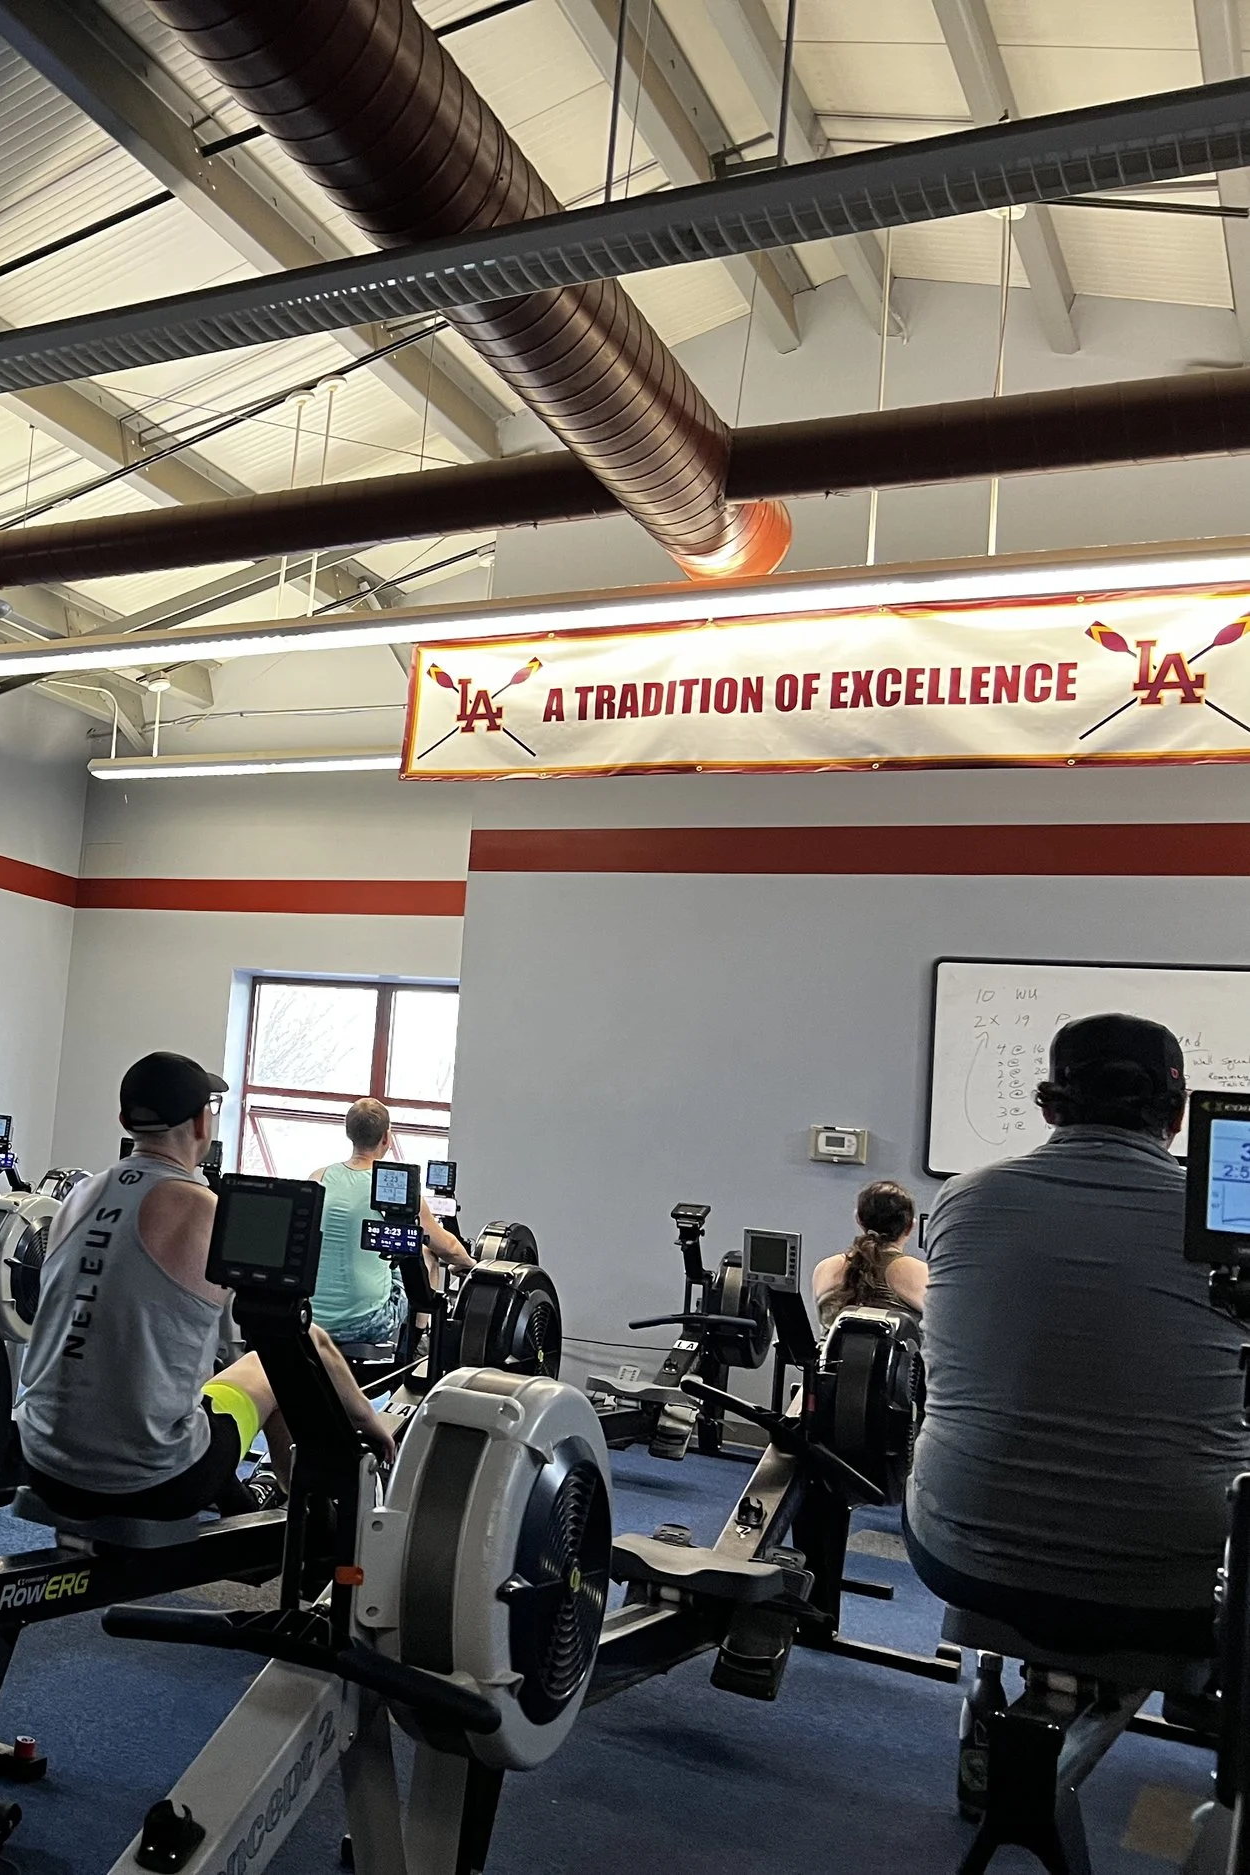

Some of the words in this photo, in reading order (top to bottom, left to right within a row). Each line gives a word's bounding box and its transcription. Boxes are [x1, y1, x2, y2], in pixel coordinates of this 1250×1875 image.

[542, 688, 565, 722] A
[575, 676, 764, 721] TRADITION
[775, 673, 820, 712] OF
[830, 662, 1078, 710] EXCELLENCE
[1133, 640, 1206, 705] LA
[456, 679, 503, 733] LA
[975, 988, 995, 1004] 10
[62, 1207, 123, 1360] NELEUS
[217, 1741, 315, 1875] ncept
